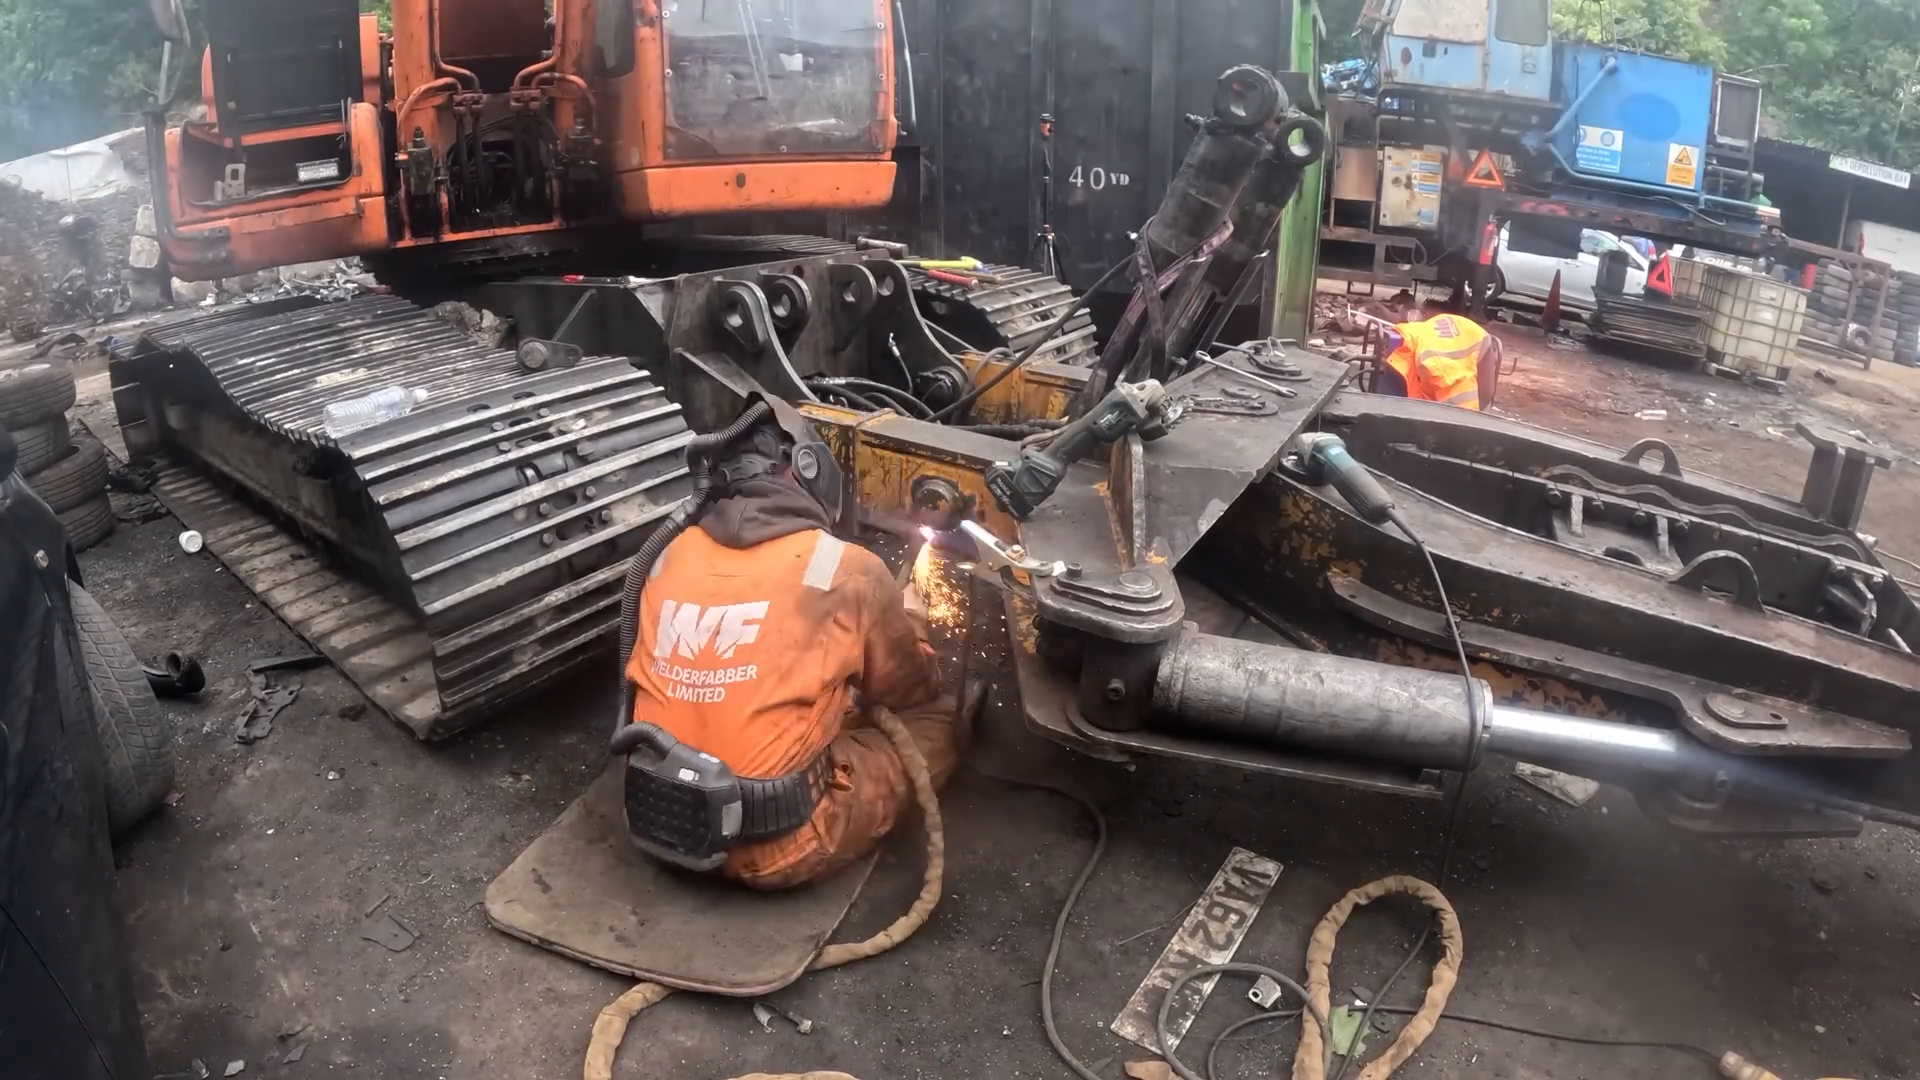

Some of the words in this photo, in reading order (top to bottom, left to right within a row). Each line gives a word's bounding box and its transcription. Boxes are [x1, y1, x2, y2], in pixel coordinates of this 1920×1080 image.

[1069, 166, 1105, 190] 40
[1110, 172, 1130, 186] YD
[1849, 160, 1893, 181] DEPOLLUTION
[1894, 171, 1909, 184] BAY
[667, 681, 726, 703] LIMITED
